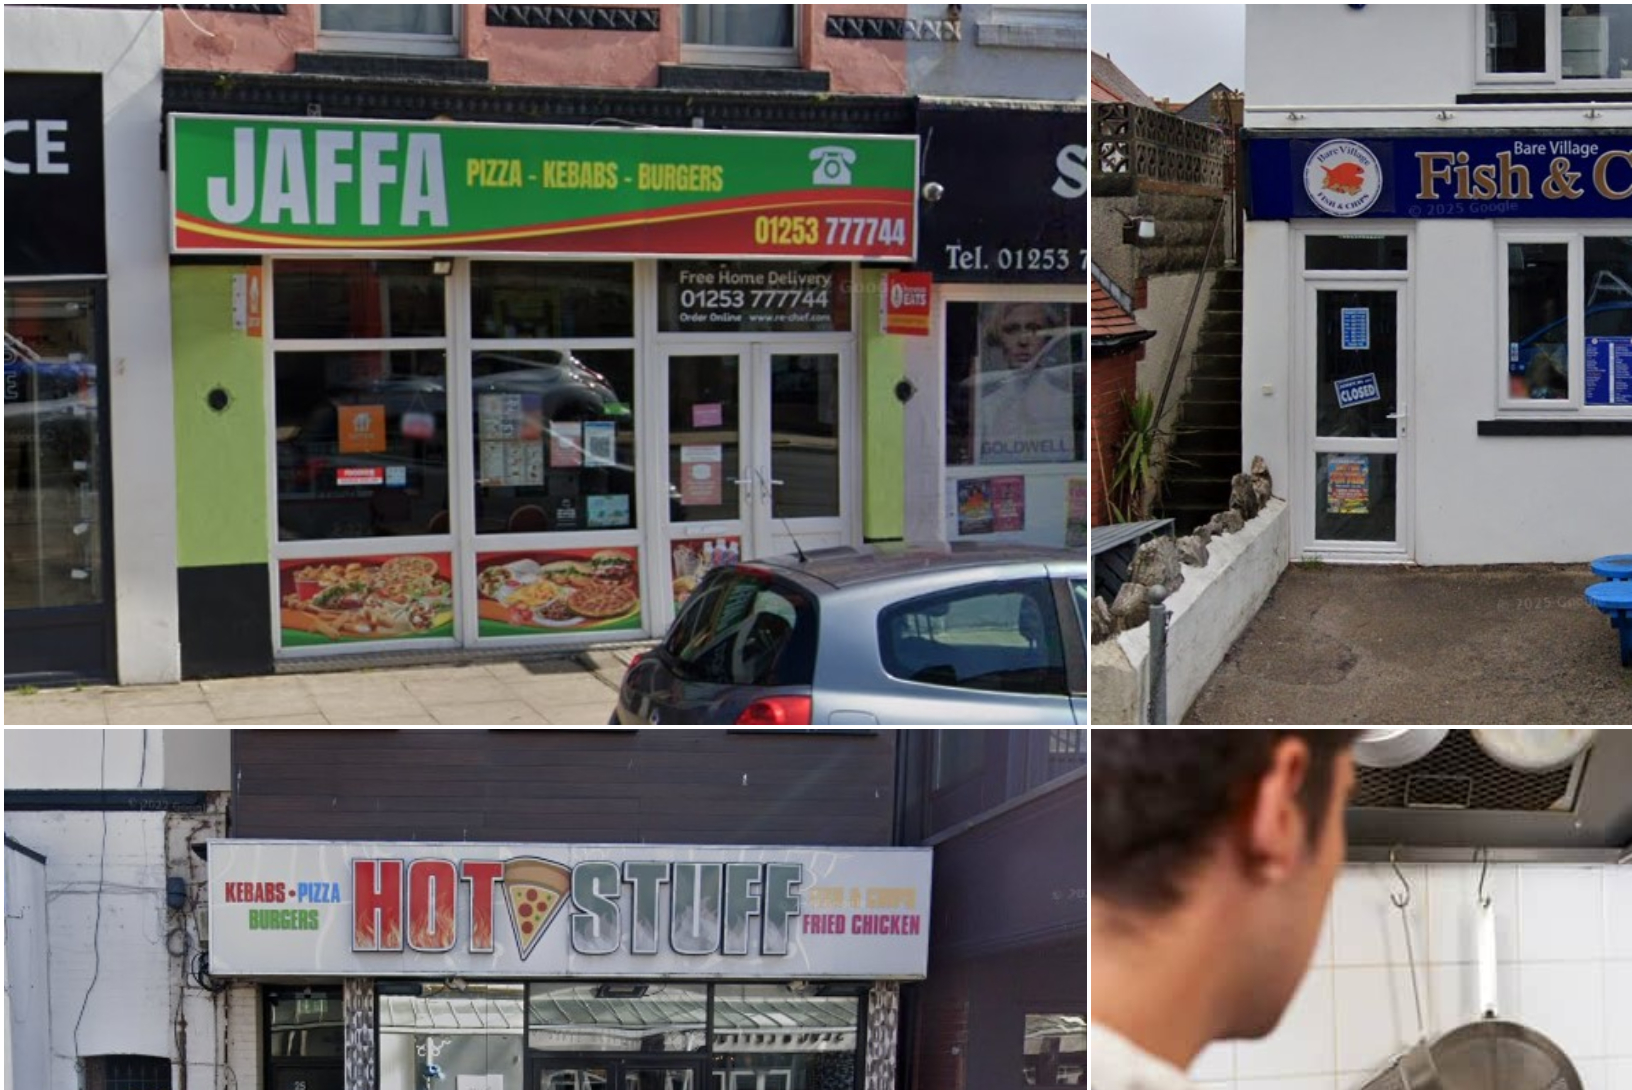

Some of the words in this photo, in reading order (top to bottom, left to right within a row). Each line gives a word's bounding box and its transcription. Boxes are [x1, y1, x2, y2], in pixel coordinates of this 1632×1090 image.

[1317, 148, 1339, 163] Bare
[1338, 146, 1371, 166] Village
[1514, 141, 1546, 156] Bare
[1549, 141, 1599, 158] Village
[207, 127, 449, 227] JAFFA
[466, 159, 521, 187] PIZZA
[543, 160, 618, 190] KEBABS
[638, 163, 723, 192] BURGERS
[1052, 144, 1087, 199] S
[1415, 150, 1531, 200] Fish
[1544, 156, 1584, 199] &
[755, 216, 818, 246] 01253
[826, 217, 905, 246] 777744
[946, 245, 988, 270] Tel.
[998, 248, 1069, 270] 01253
[680, 270, 714, 285] Free
[718, 271, 763, 284] Home
[768, 271, 832, 288] Delivery
[680, 289, 744, 308] 01253
[751, 290, 828, 307] 777744
[680, 313, 707, 322] Order
[710, 313, 742, 322] Online
[1341, 384, 1375, 402] CLOSED
[981, 438, 1069, 455] GOLDWELL
[225, 882, 286, 904] KEBABS
[298, 882, 341, 904] PIZZA
[351, 858, 505, 953] HOT
[572, 861, 803, 956] STUFF
[248, 909, 319, 931] BURGERS
[803, 914, 846, 935] FRIED
[851, 914, 920, 936] CHICKEN
